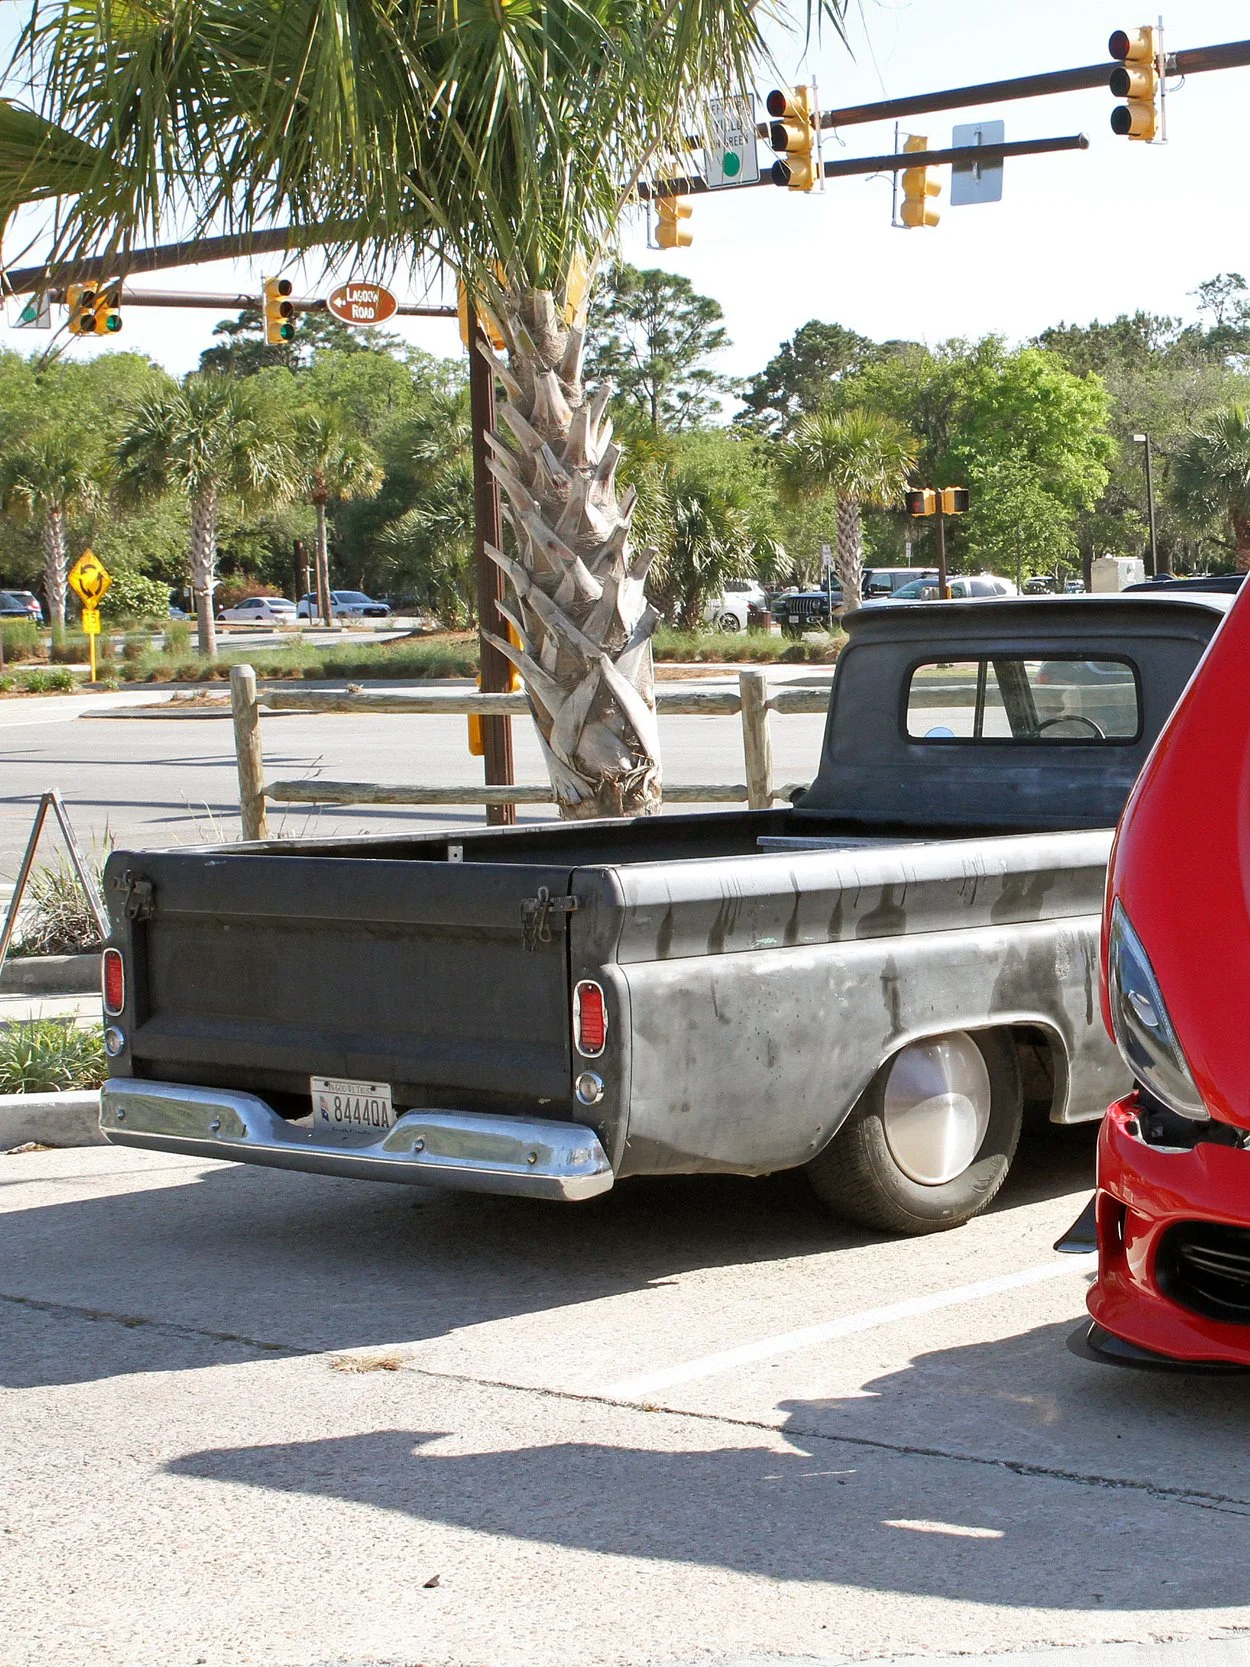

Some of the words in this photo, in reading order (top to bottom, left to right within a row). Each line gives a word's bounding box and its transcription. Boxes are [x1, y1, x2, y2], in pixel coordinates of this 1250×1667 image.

[346, 287, 379, 303] LAGOON
[351, 304, 375, 319] ROAD
[334, 1096, 389, 1128] 8444QA
